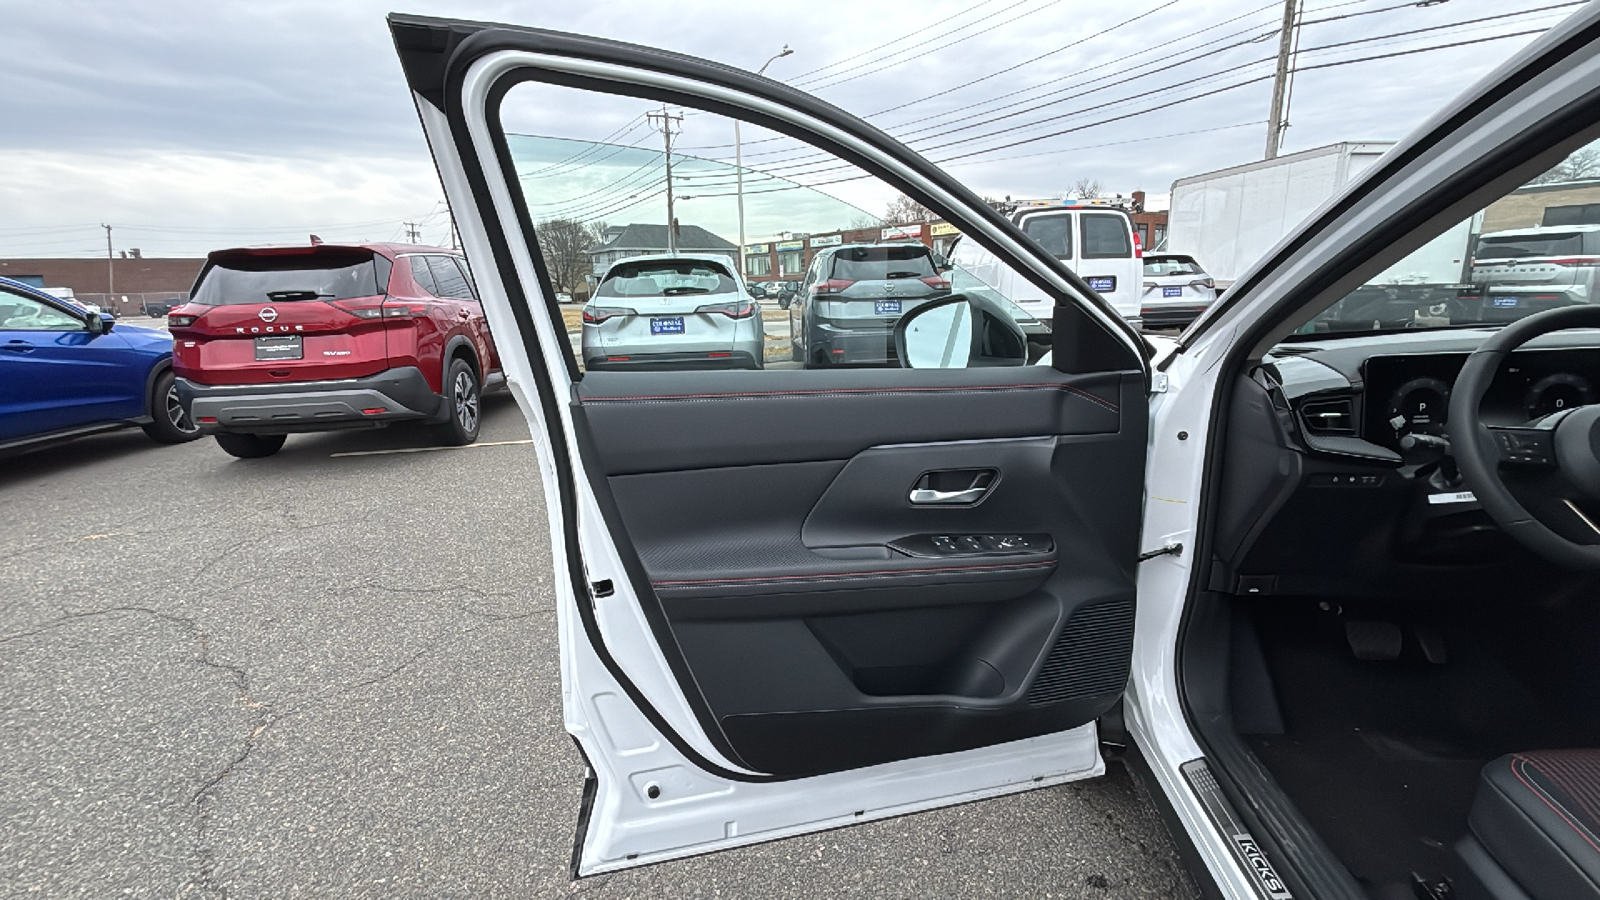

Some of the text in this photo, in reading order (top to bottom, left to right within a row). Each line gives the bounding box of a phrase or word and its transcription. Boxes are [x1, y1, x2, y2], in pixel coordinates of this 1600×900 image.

[236, 325, 303, 334] ROGUE
[1419, 402, 1427, 412] P
[1241, 842, 1282, 891] KICKS
